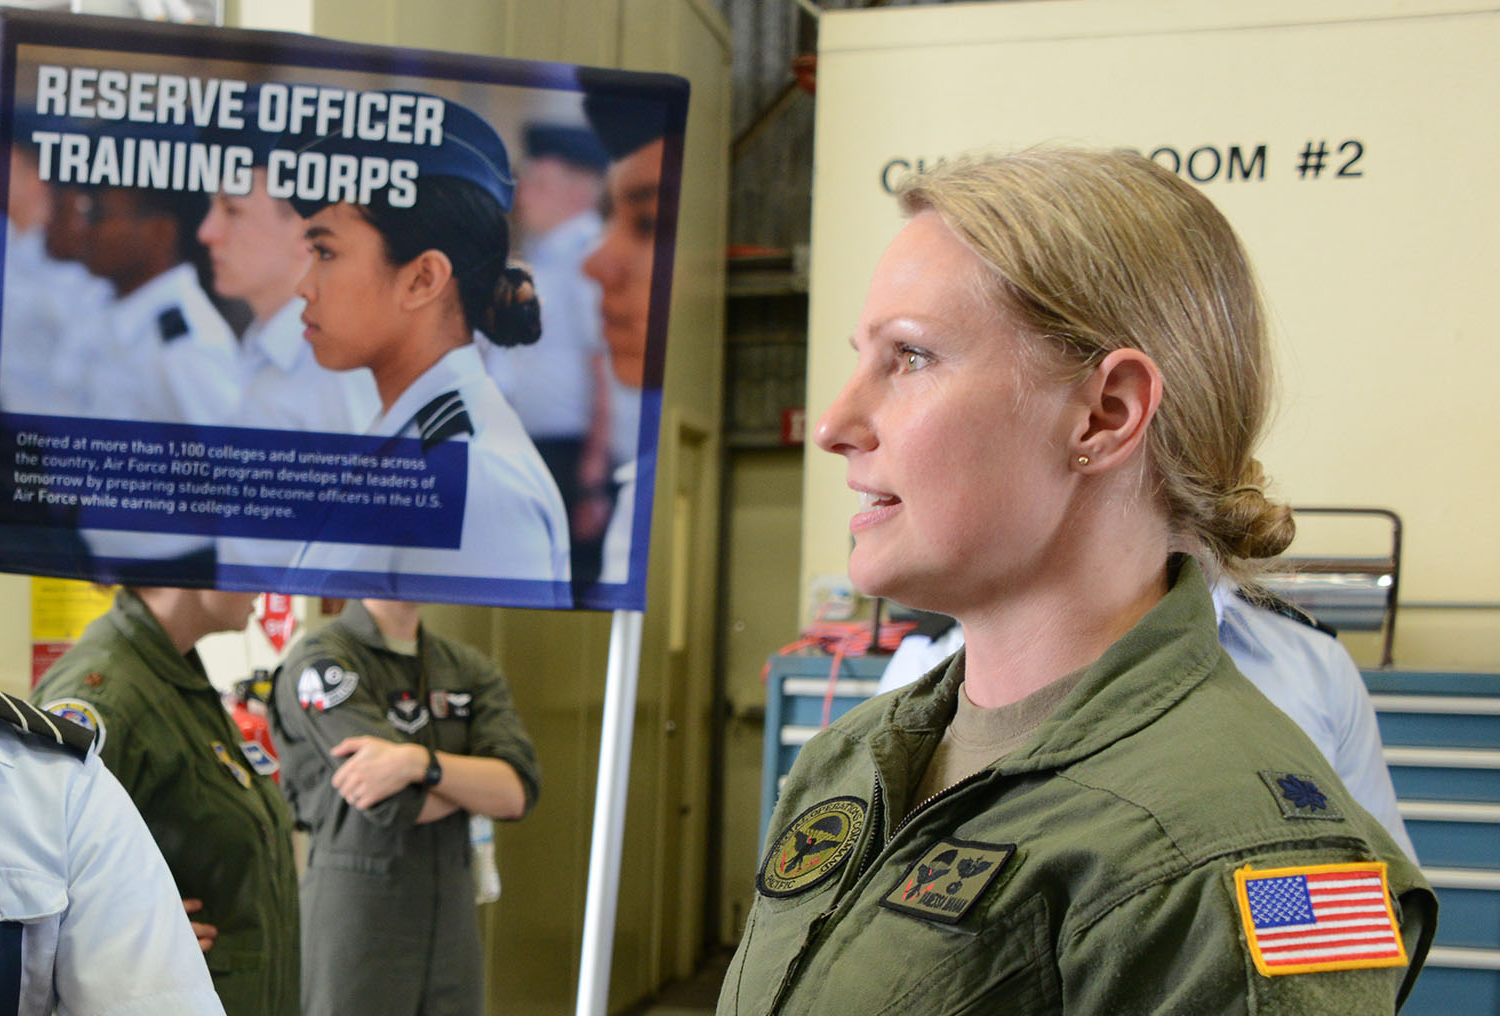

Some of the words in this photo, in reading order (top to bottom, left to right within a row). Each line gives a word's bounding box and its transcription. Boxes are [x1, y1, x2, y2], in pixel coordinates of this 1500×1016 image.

[36, 65, 247, 131] RESERVE
[258, 82, 446, 146] OFFICER
[32, 131, 254, 196] TRAINING
[266, 148, 420, 209] CORPS
[1112, 145, 1268, 183] OOM
[1296, 139, 1366, 181] #2
[15, 452, 38, 466] the
[103, 457, 124, 471] Air
[128, 459, 168, 474] Force
[171, 460, 211, 477] ROTC
[213, 465, 274, 482] program
[276, 468, 338, 486] develops
[341, 471, 364, 486] the
[366, 472, 418, 489] leaders
[420, 475, 436, 489] of
[16, 431, 70, 450] Offered
[73, 437, 87, 450] at
[90, 440, 129, 452] more
[132, 440, 164, 455] than
[169, 442, 205, 459] 1,100
[207, 446, 266, 465] colleges
[268, 450, 296, 464] and
[298, 452, 379, 468] universities
[381, 457, 427, 471] across
[13, 471, 84, 487] tomorrow
[86, 475, 102, 490] by
[106, 476, 176, 495] preparing
[178, 481, 239, 497] students
[243, 484, 257, 498] to
[259, 485, 315, 501] become
[317, 488, 370, 505] officers
[373, 491, 387, 505] in
[389, 492, 412, 507] the
[415, 493, 443, 509] U.S.
[13, 488, 34, 502] Air
[38, 490, 78, 506] Force
[80, 493, 119, 508] while
[121, 497, 176, 515] earning
[178, 501, 188, 512] a
[190, 499, 241, 517] college
[243, 502, 297, 520] degree.
